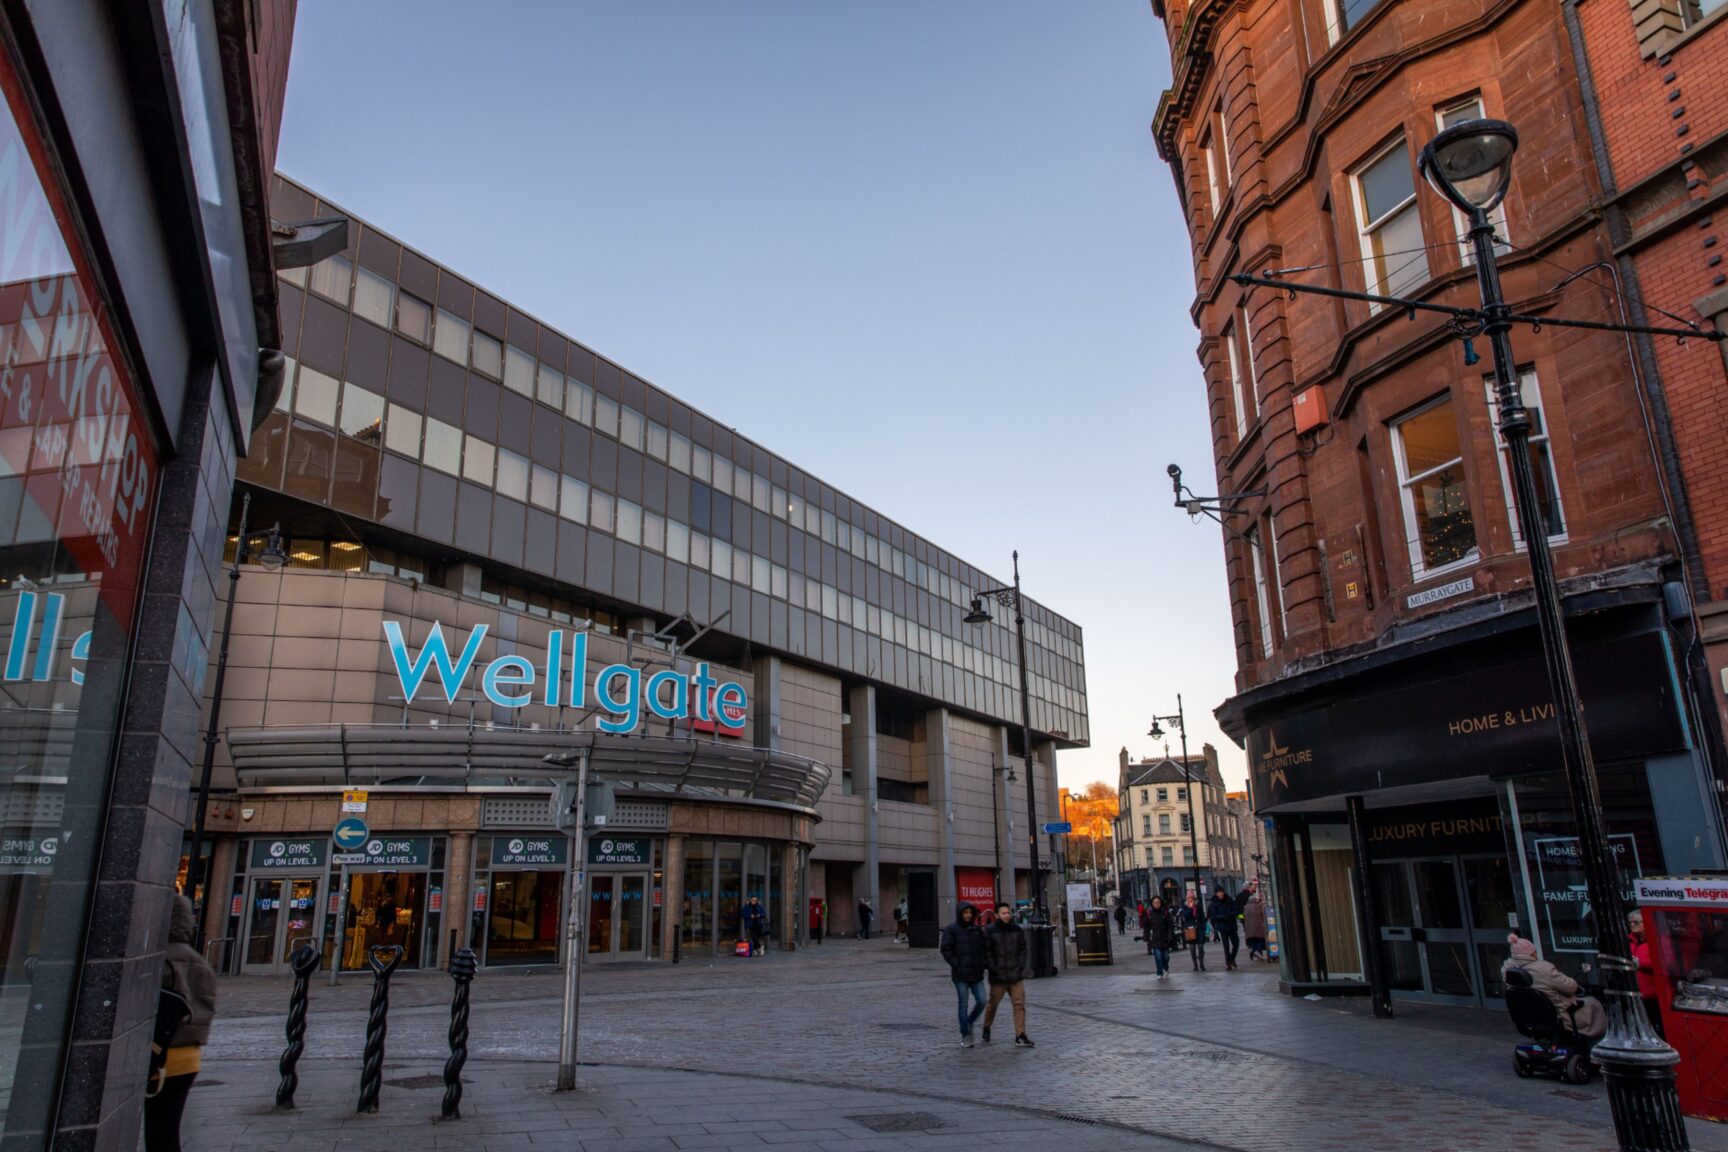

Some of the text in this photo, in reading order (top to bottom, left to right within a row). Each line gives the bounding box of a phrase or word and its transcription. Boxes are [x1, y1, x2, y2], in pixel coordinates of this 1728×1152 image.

[80, 480, 118, 568] REPAIRS
[1409, 580, 1471, 606] MURRAYGATE
[382, 619, 748, 733] Wellgate
[1449, 714, 1500, 735] HOME
[1504, 711, 1516, 726] &
[1368, 811, 1551, 842] UXURY FURNITRE
[288, 844, 311, 854] GYMS
[387, 842, 410, 852] GYMS
[527, 841, 549, 851] GYMS
[616, 842, 635, 851] GYMS
[1546, 846, 1577, 856] HOME
[263, 857, 317, 866] UP ON LEVEL 3
[373, 856, 384, 864] ON
[970, 887, 993, 897] HUGHES
[1543, 891, 1575, 901] FAME
[1640, 887, 1684, 900] Evening
[1562, 936, 1593, 944] LUXURY
